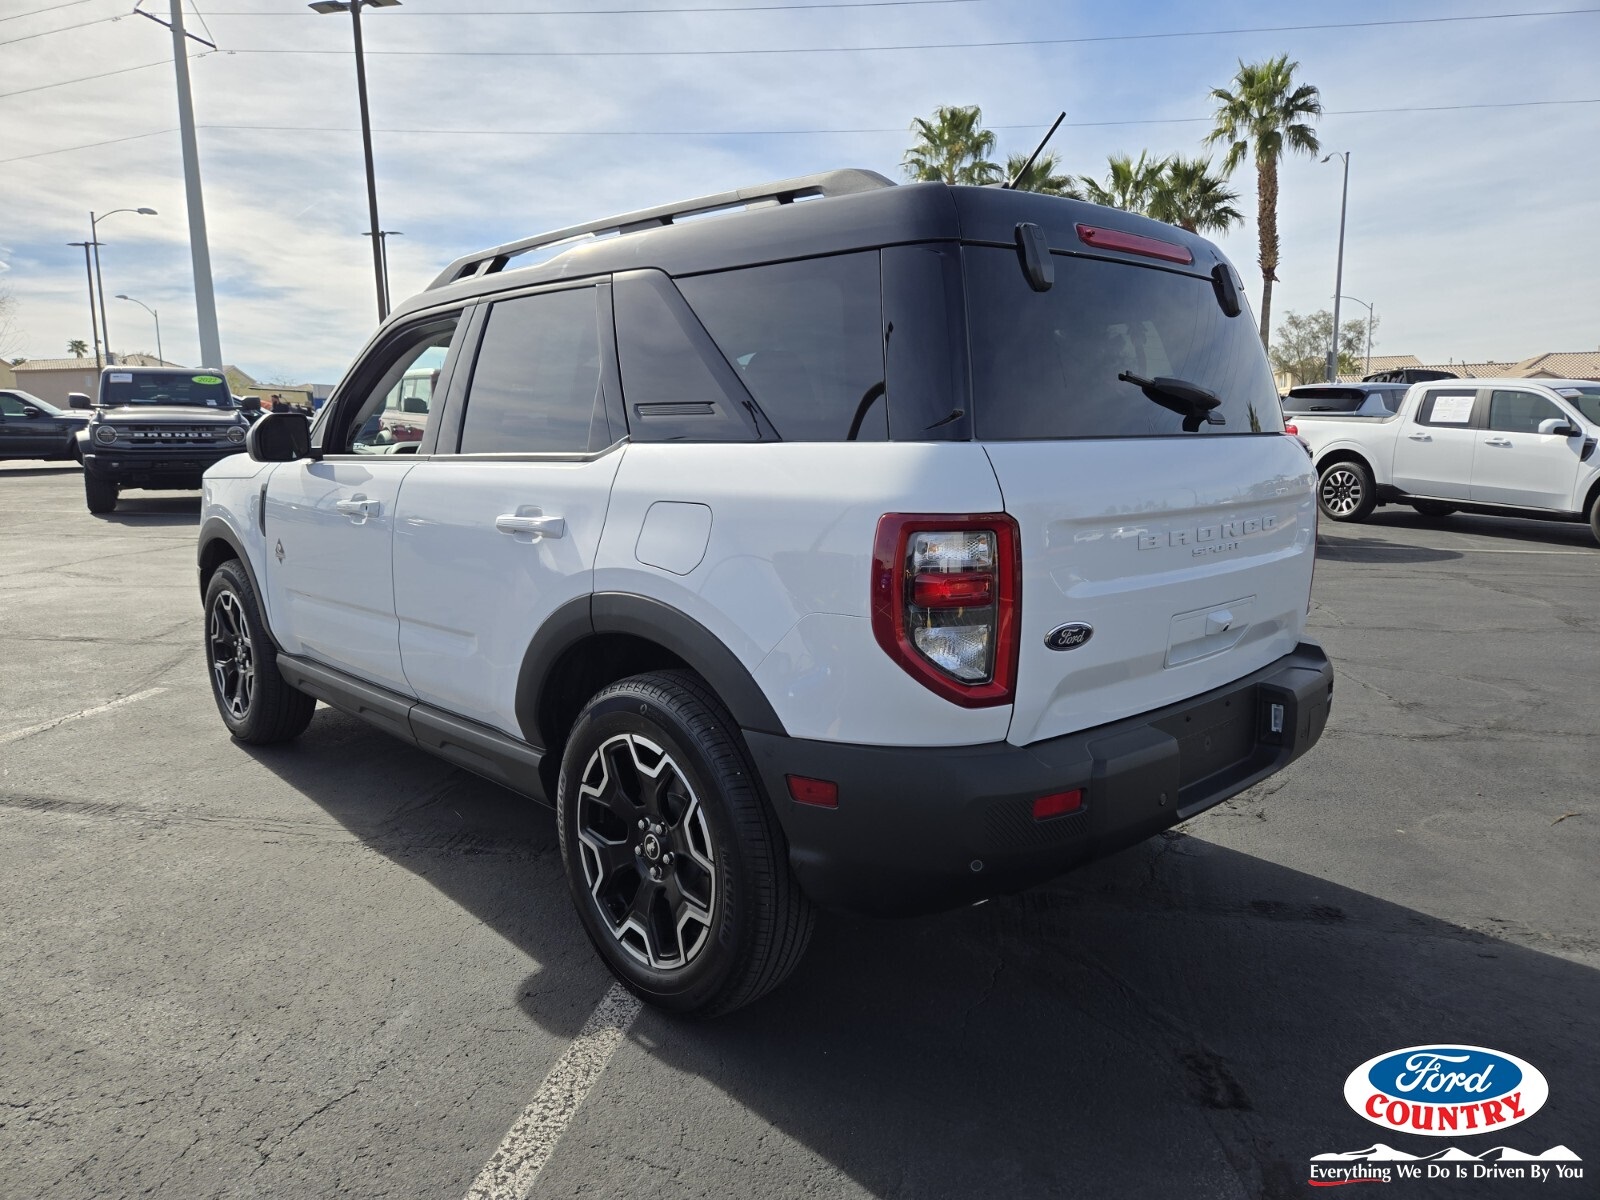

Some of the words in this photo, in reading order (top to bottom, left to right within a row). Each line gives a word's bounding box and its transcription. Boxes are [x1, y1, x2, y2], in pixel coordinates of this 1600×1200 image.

[1137, 515, 1277, 550] BRONCO
[1191, 541, 1241, 557] SPORT
[1058, 628, 1085, 645] Ford
[720, 849, 736, 945] MICHELIN
